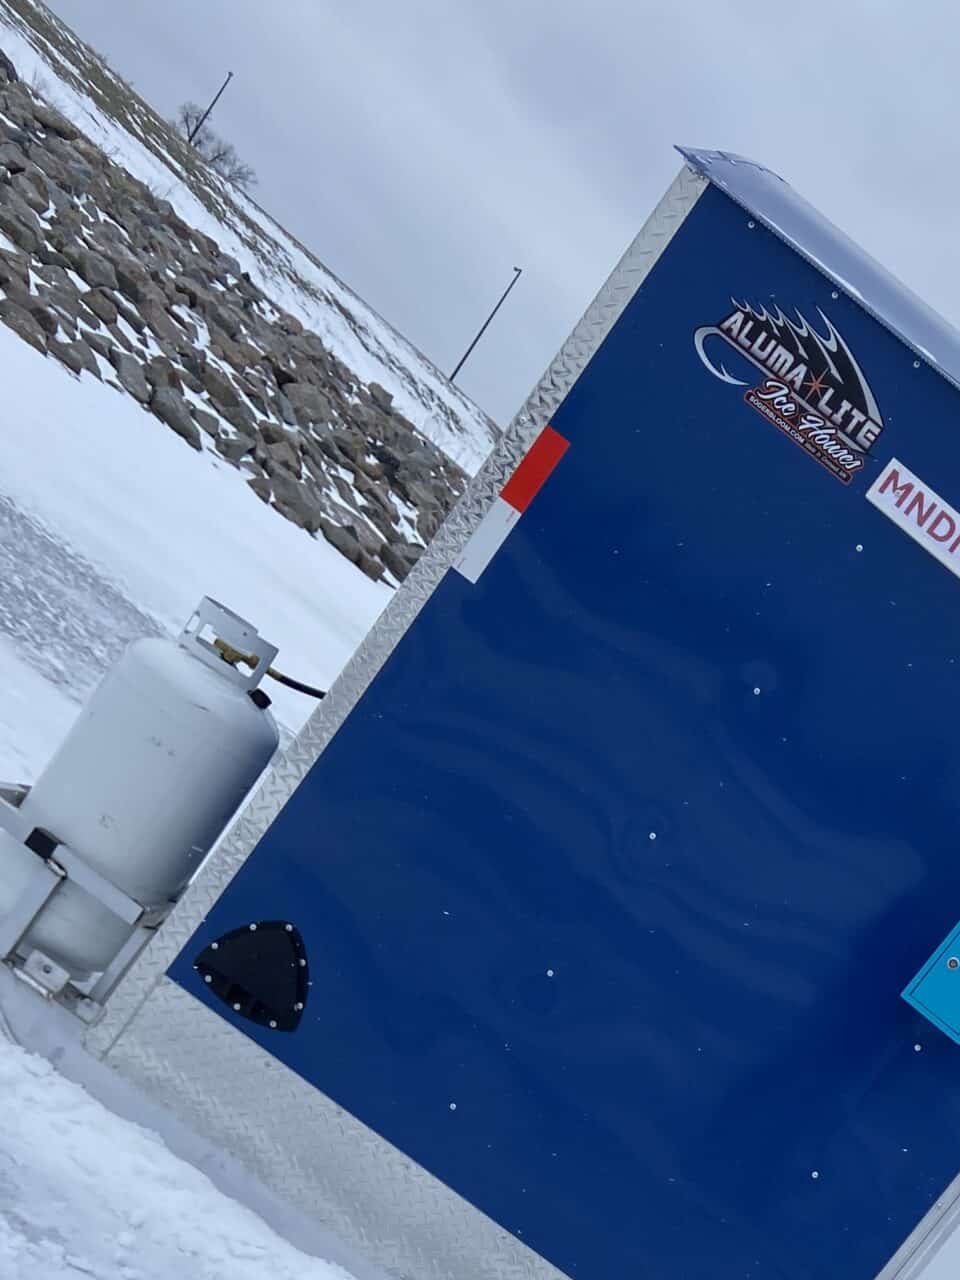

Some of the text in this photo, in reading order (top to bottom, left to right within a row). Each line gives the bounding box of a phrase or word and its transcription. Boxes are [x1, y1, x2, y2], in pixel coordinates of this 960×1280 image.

[720, 311, 881, 447] ALUMA LITE
[757, 380, 795, 416] Ice
[799, 415, 862, 469] Houses
